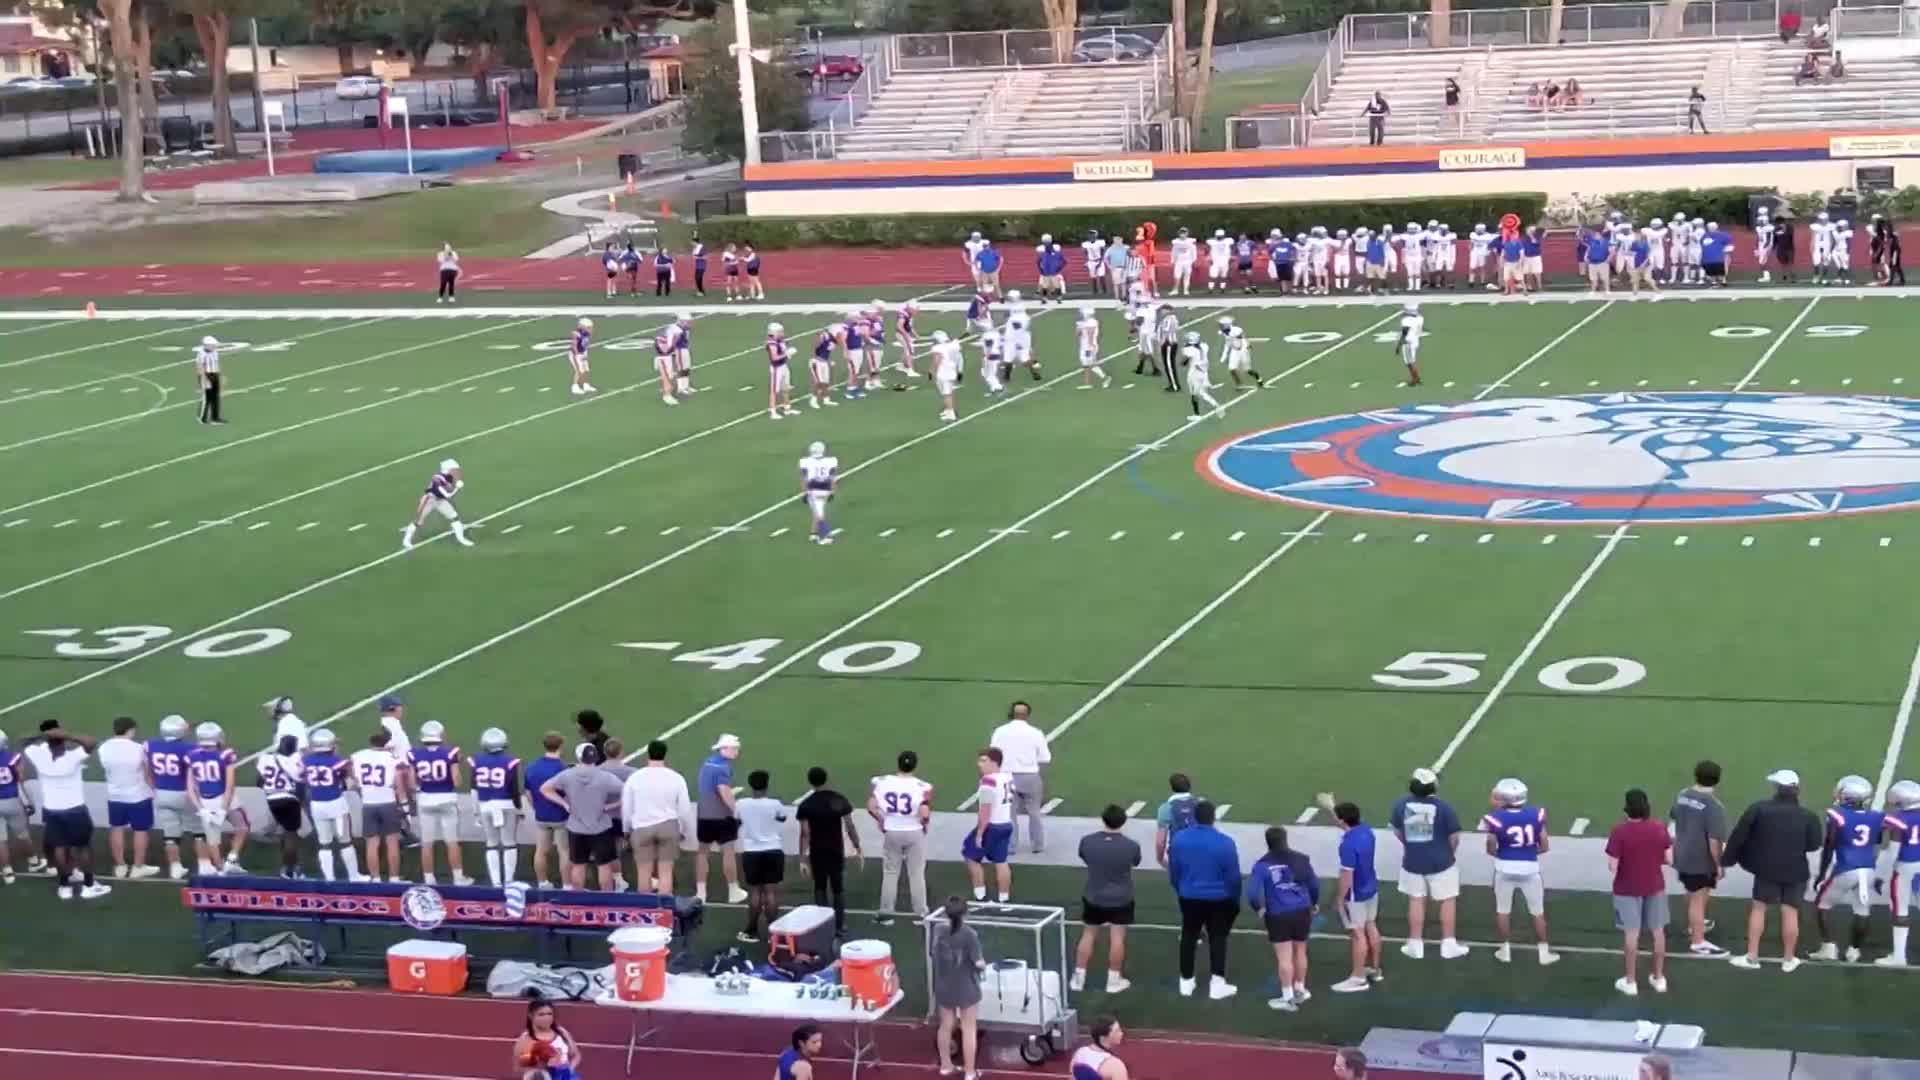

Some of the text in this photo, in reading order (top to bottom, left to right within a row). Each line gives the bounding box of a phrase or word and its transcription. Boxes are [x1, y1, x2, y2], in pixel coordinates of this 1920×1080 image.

[1444, 152, 1519, 164] COURAGE
[152, 754, 180, 776] 56
[193, 760, 221, 783] 30
[306, 765, 335, 787] 23
[361, 763, 386, 786] 23
[417, 759, 447, 782] 20
[475, 767, 506, 788] 29
[884, 791, 913, 815] 93
[1506, 824, 1535, 847] 31
[1852, 824, 1871, 846] 3
[190, 892, 390, 914] BULLDOG
[409, 961, 426, 978] G
[625, 962, 641, 977] G
